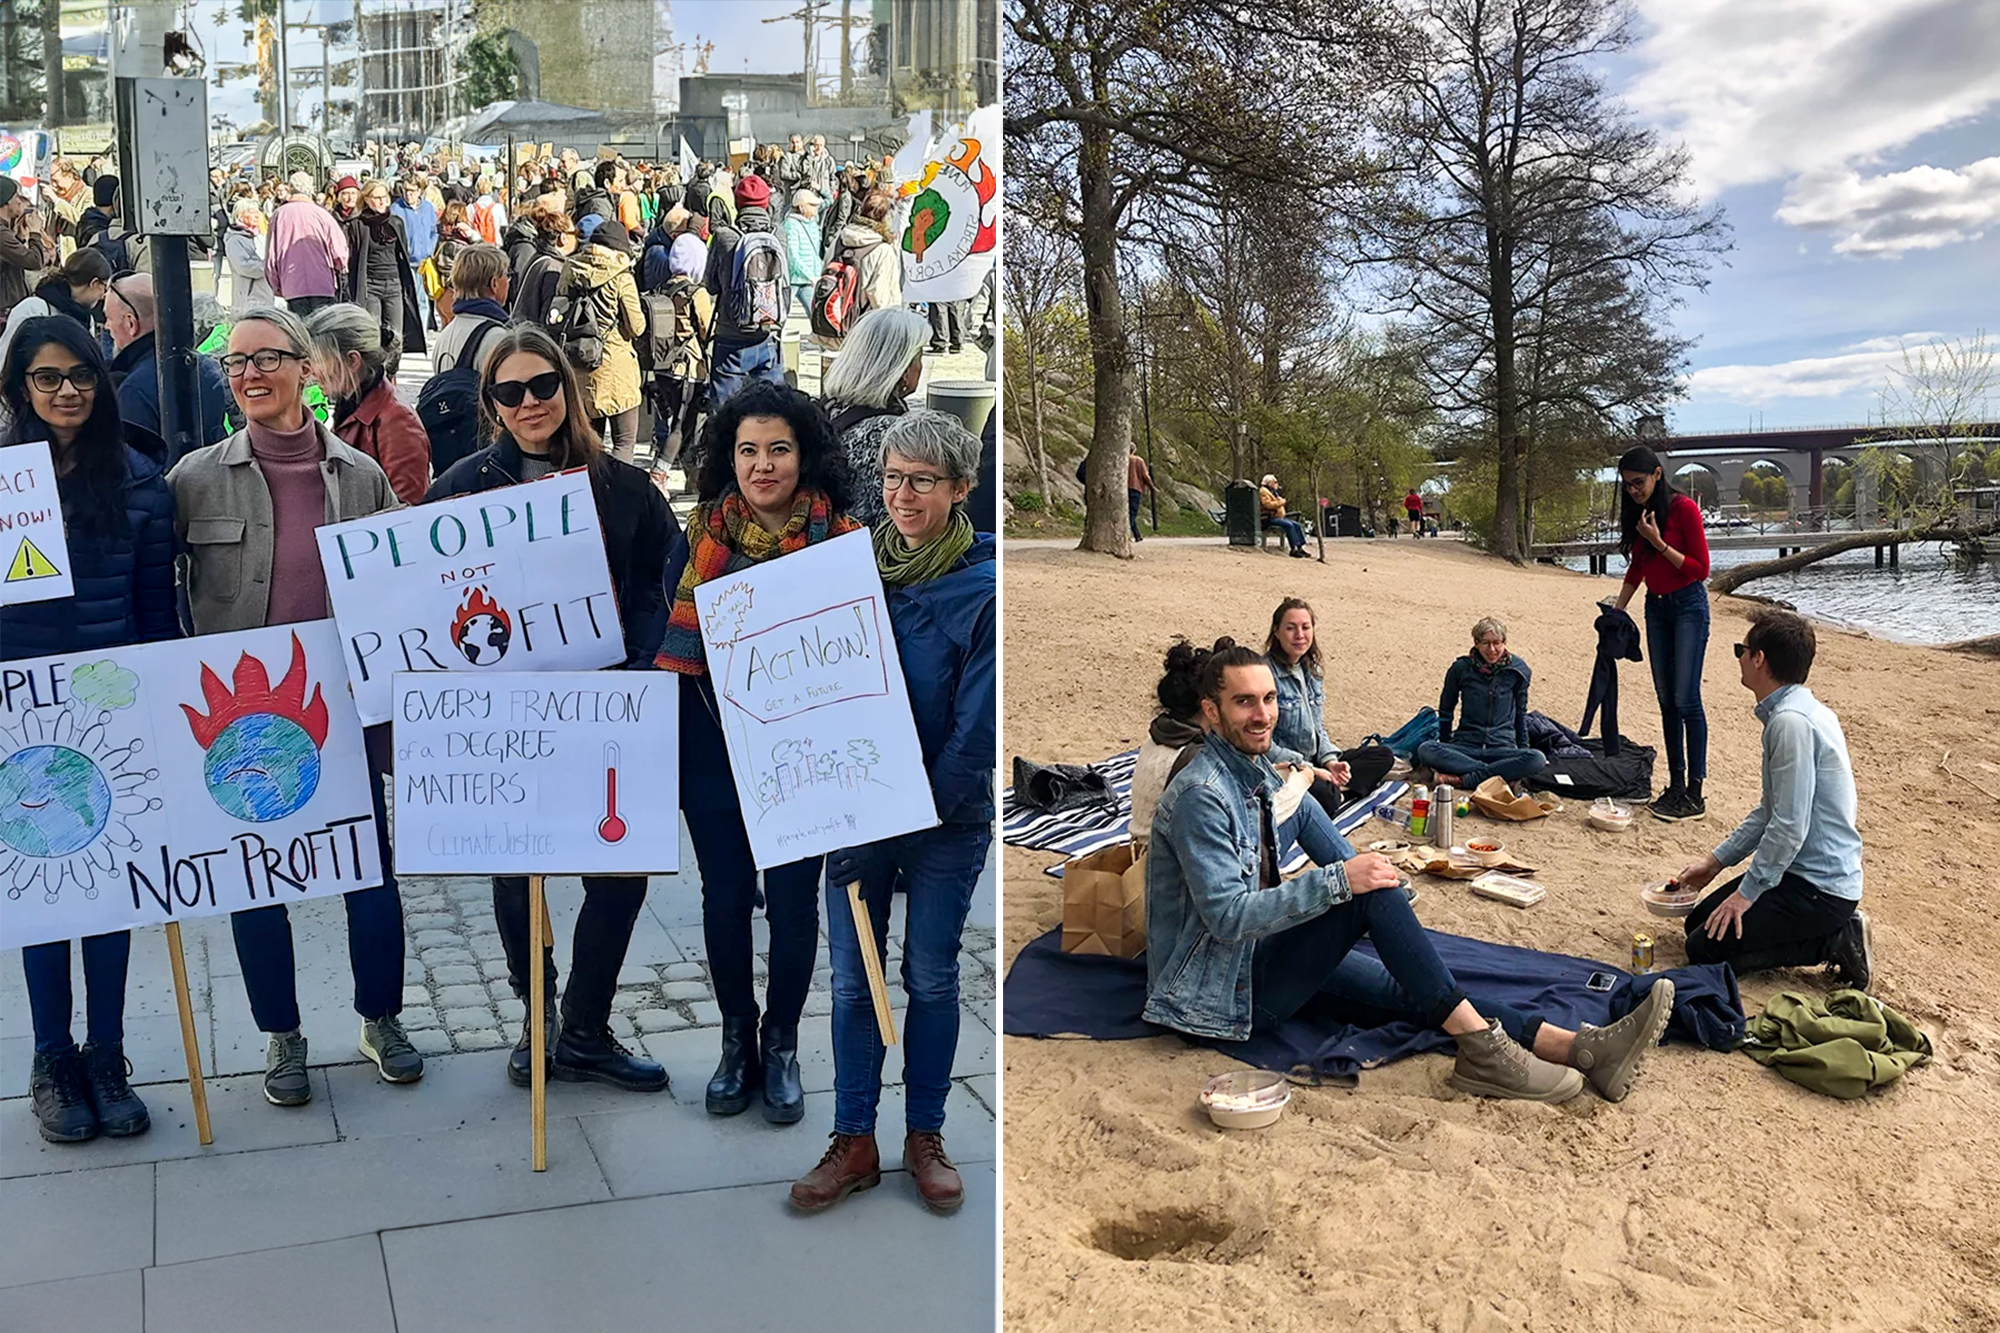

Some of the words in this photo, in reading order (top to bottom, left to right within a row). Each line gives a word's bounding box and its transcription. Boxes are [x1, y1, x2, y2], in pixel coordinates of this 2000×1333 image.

[0, 466, 36, 495] ACT
[0, 508, 53, 532] NOW!
[331, 488, 591, 580] PEOPLE
[440, 562, 495, 585] NOT
[0, 662, 66, 713] PLE
[403, 688, 492, 722] EVERY
[509, 684, 649, 723] FRACTION
[793, 694, 802, 704] A
[444, 730, 558, 764] DEGREE
[406, 771, 527, 806] MATTERS
[126, 845, 228, 917] NOT
[230, 814, 373, 900] PROFIT
